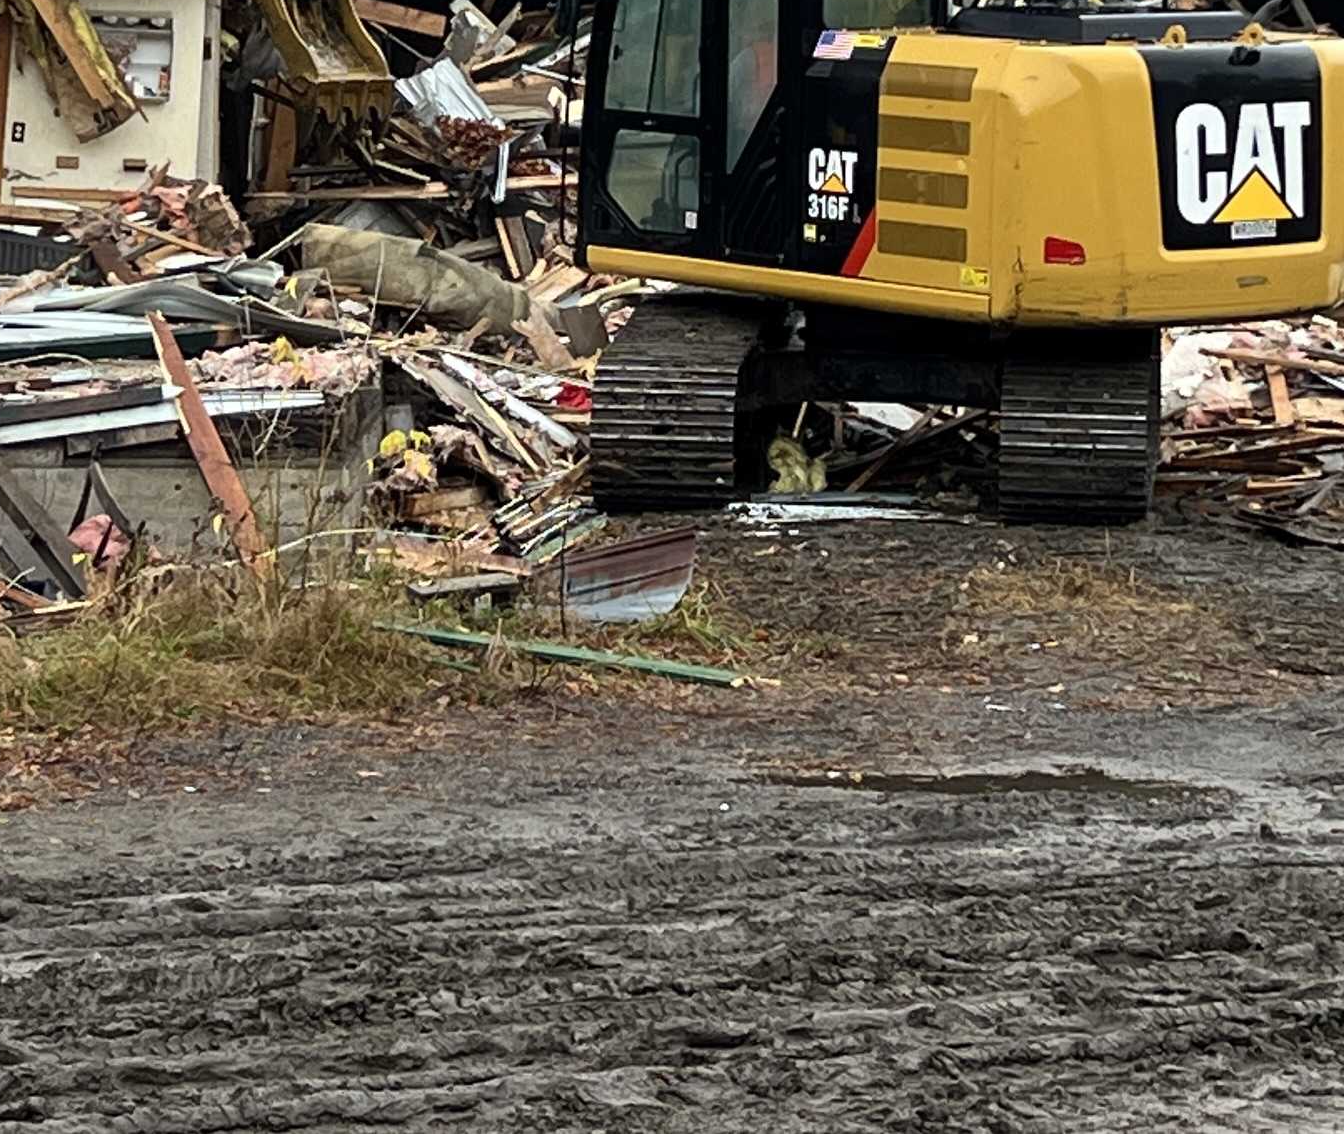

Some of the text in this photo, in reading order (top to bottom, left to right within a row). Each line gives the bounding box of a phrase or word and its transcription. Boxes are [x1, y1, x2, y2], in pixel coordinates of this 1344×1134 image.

[808, 148, 858, 194] CAT
[1175, 101, 1311, 224] CAT
[808, 194, 849, 221] 316F
